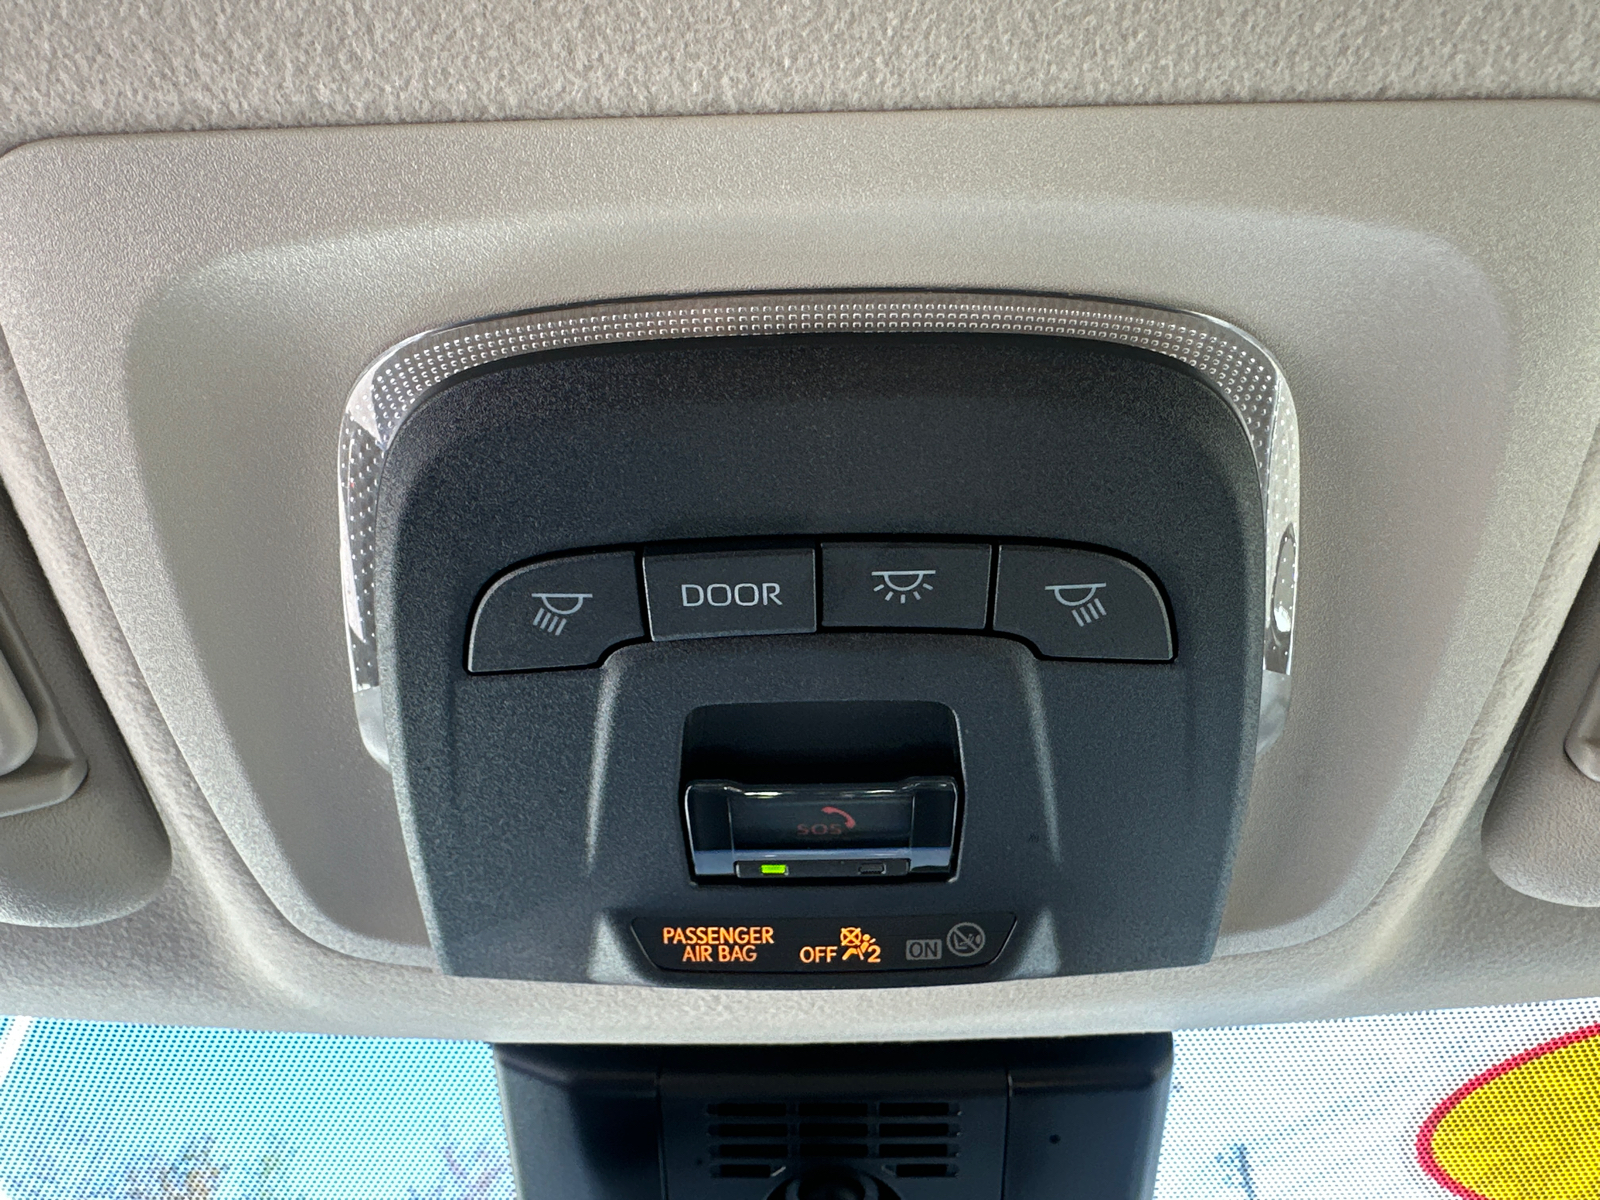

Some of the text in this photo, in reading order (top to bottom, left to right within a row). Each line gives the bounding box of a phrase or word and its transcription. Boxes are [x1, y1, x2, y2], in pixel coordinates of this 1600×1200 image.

[681, 583, 783, 607] DOOR
[797, 823, 842, 835] SOS
[663, 926, 775, 945] PASSENGER
[682, 944, 757, 963] AIR BAG
[800, 946, 837, 963] OFF
[909, 943, 938, 960] ON
